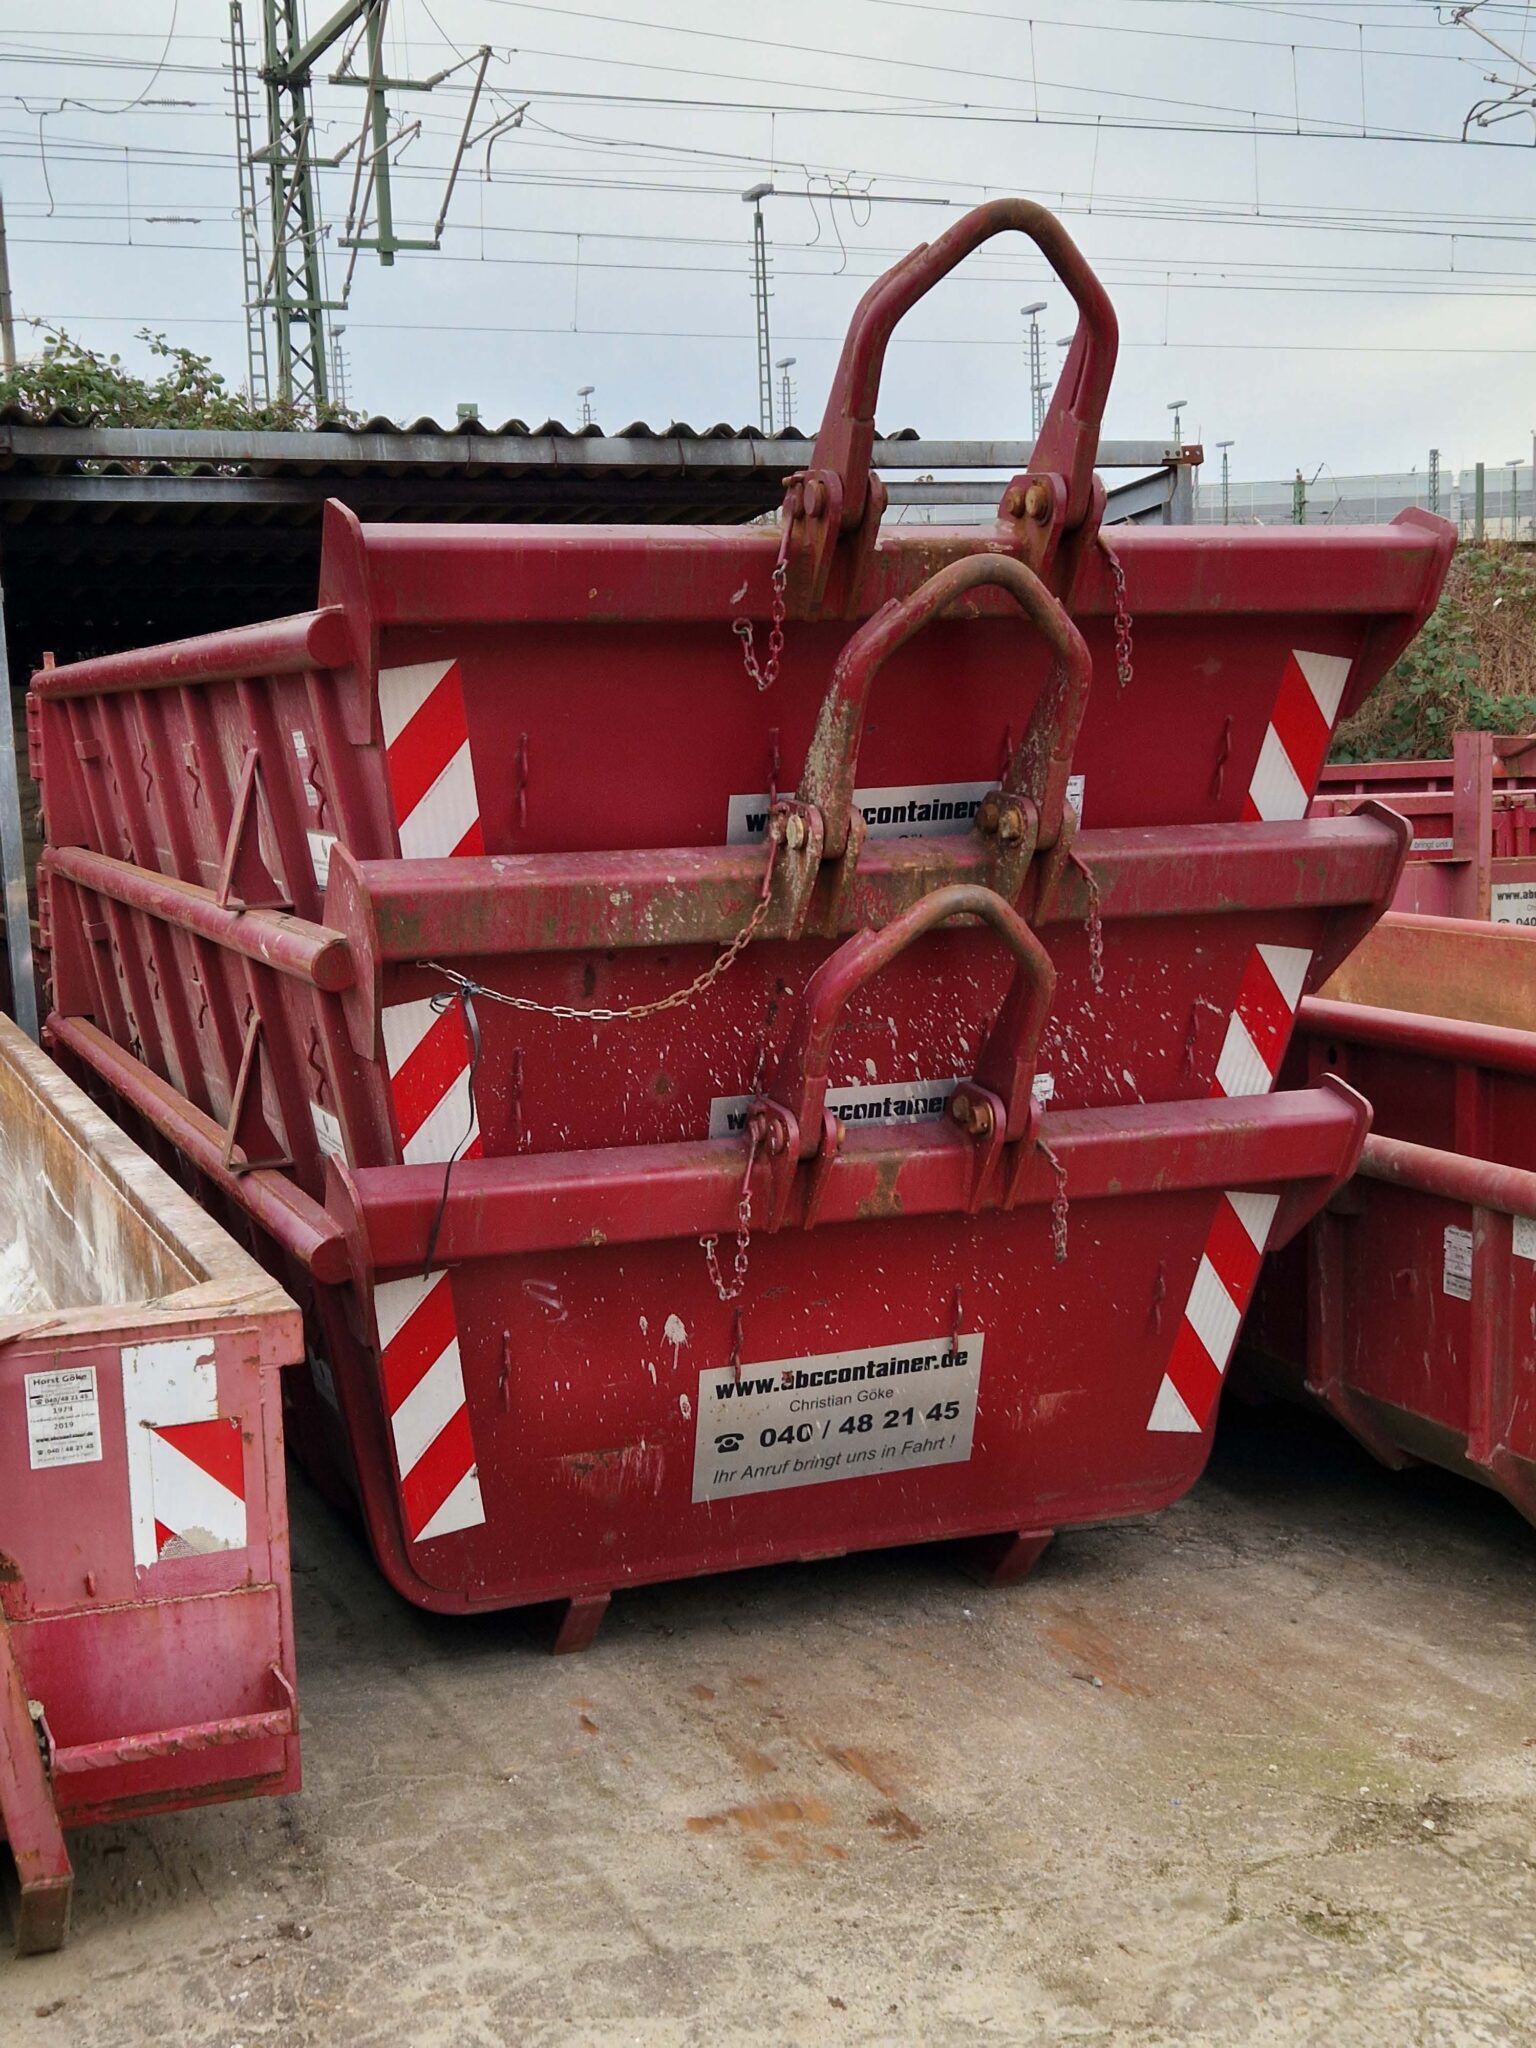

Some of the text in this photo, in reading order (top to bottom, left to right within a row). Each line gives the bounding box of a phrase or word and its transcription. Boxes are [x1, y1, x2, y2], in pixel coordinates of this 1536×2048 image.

[1497, 889, 1536, 900] www.ab
[33, 1376, 59, 1386] Horst
[61, 1373, 87, 1382] Göke
[715, 1351, 968, 1400] www.abccontainer.de
[789, 1387, 894, 1413] Christian Göke
[54, 1421, 74, 1430] 2019
[760, 1401, 960, 1447] 040 / 48 21 45
[713, 1434, 956, 1484] Ihr Anruf bringt uns in Fahrt !
